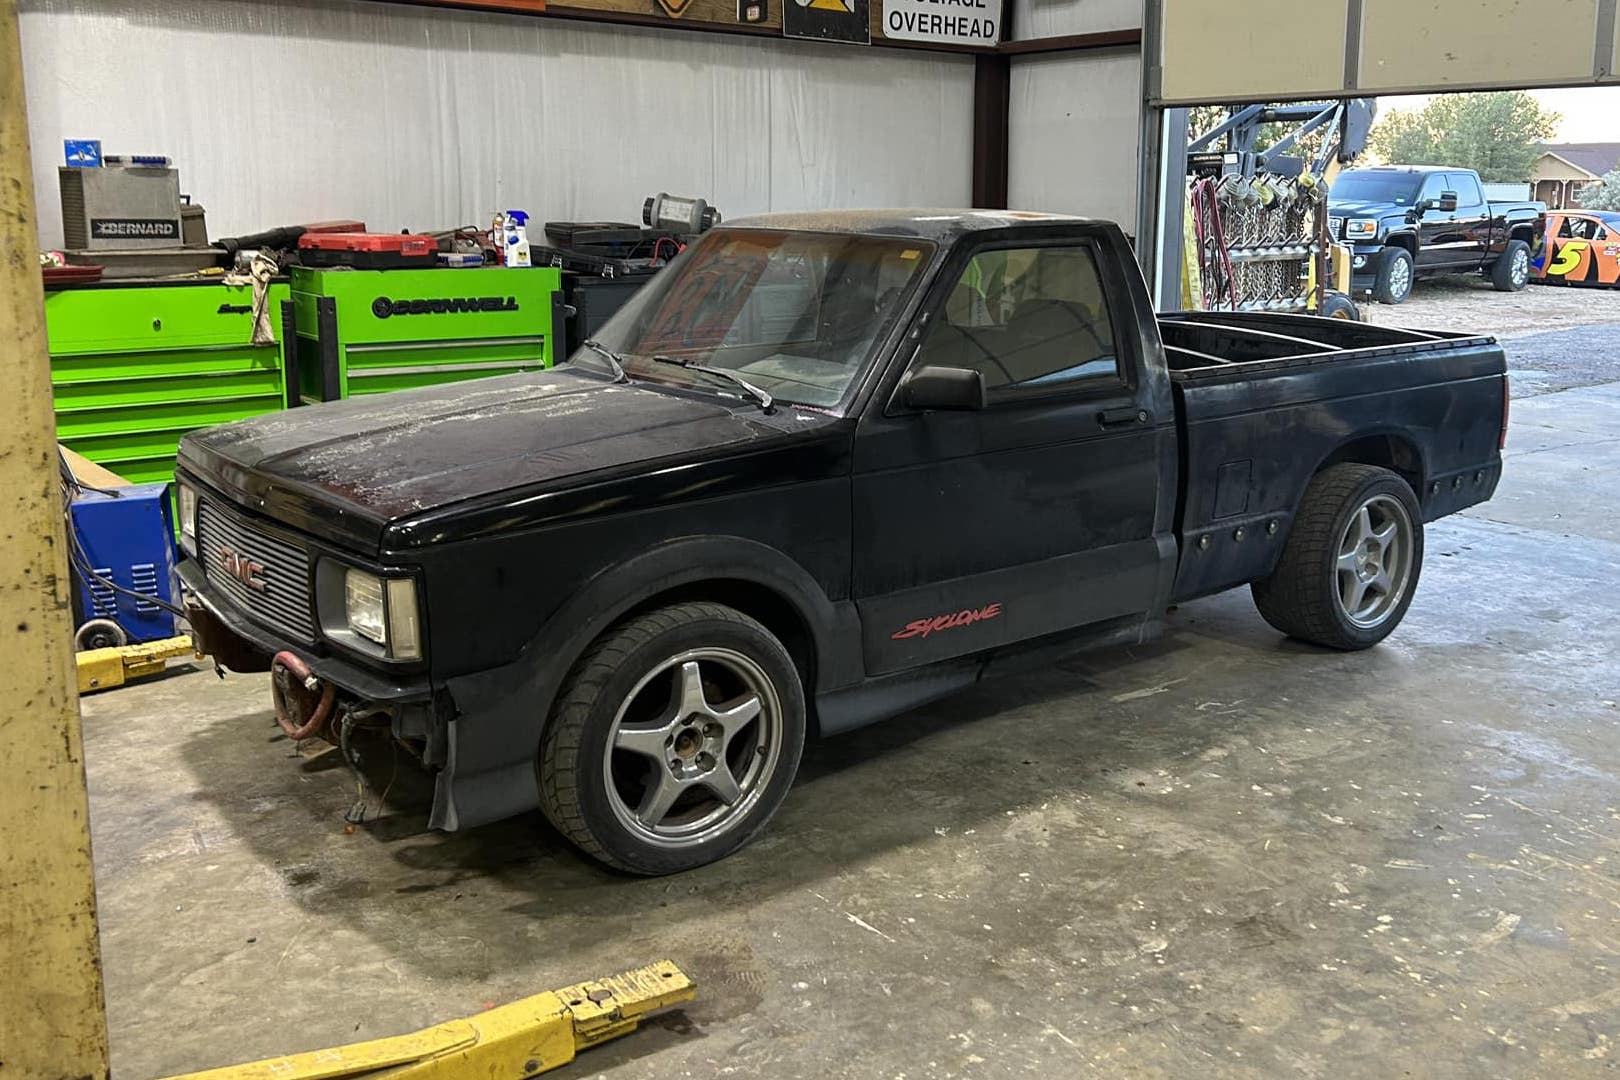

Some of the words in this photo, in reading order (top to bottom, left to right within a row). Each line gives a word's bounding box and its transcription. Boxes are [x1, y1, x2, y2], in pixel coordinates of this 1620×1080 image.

[889, 10, 995, 39] OVERHEAD
[109, 222, 174, 235] BERNARD
[1546, 241, 1590, 276] 5
[392, 296, 519, 316] CORNWELL
[220, 545, 267, 593] GMC
[891, 602, 1002, 640] SYCLONE
